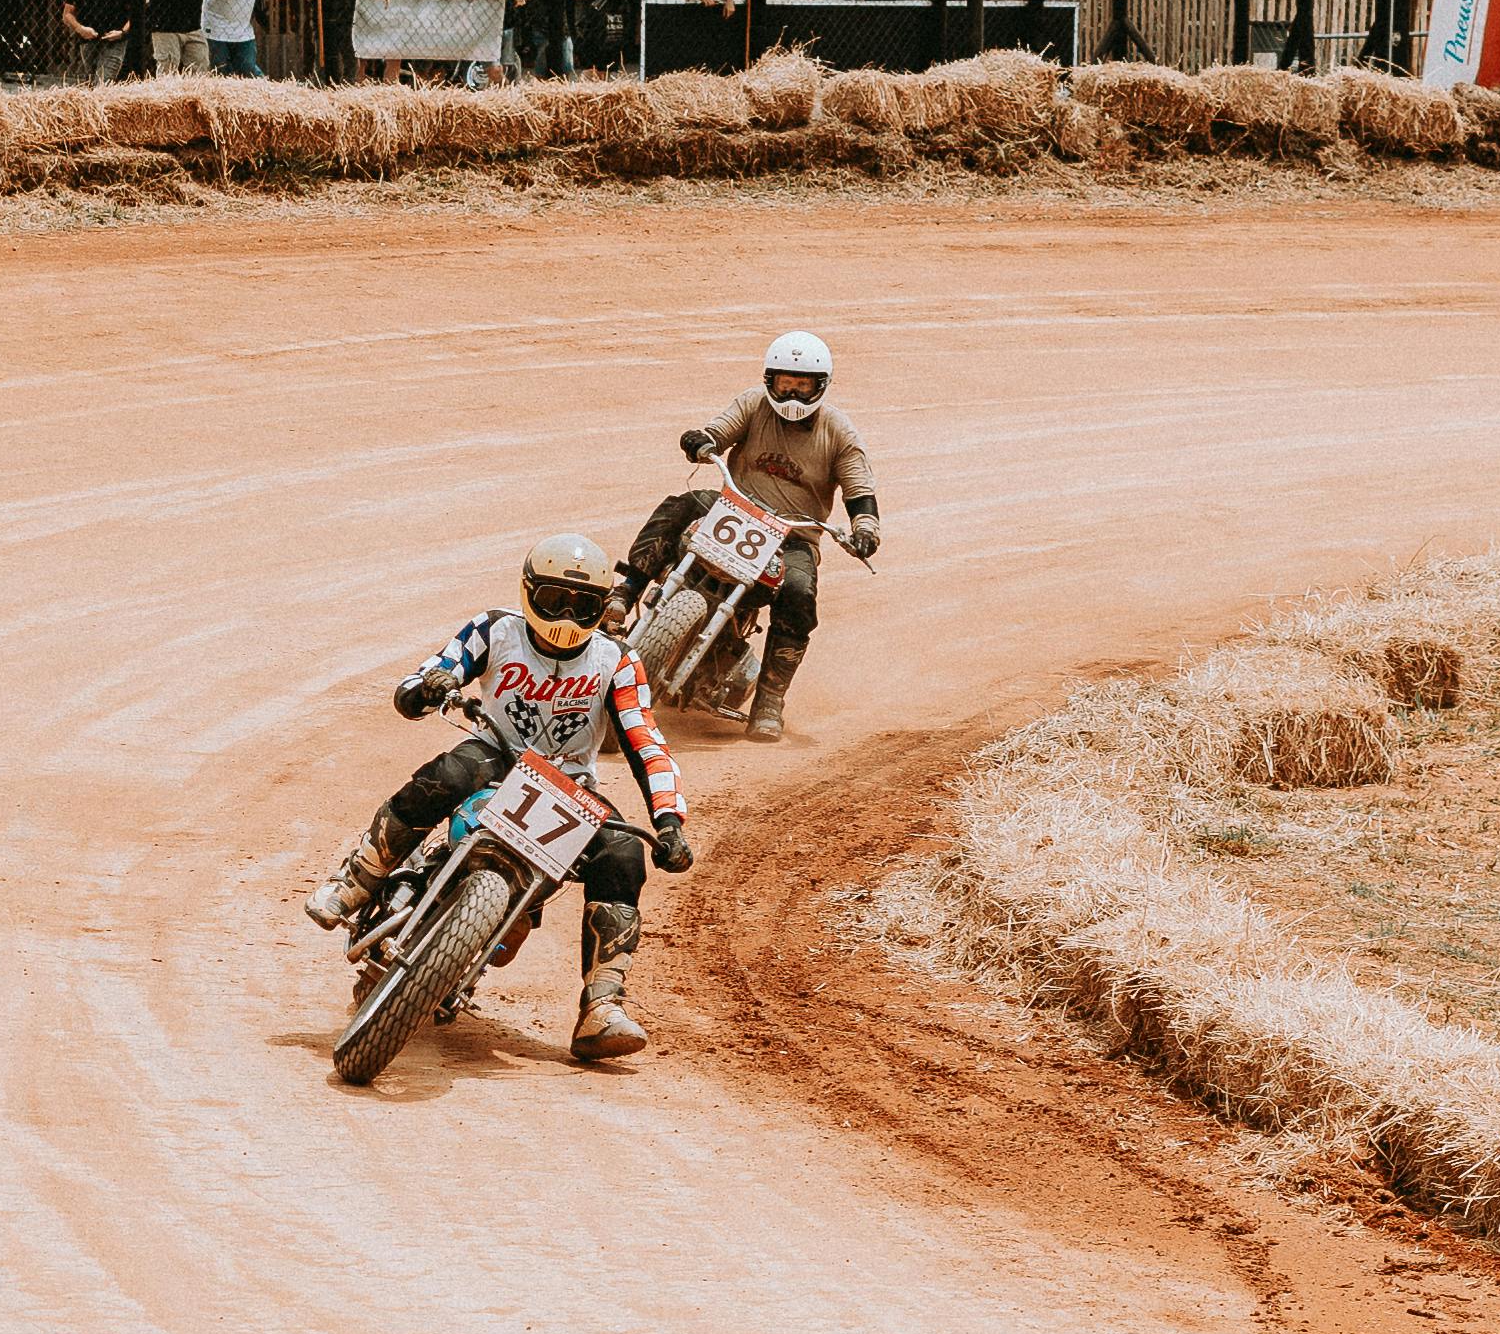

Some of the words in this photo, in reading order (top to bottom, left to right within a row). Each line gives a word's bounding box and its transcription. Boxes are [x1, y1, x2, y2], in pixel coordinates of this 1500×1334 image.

[713, 515, 767, 560] 68
[494, 662, 601, 702] Prime
[557, 698, 589, 708] RACING
[502, 783, 582, 846] 17
